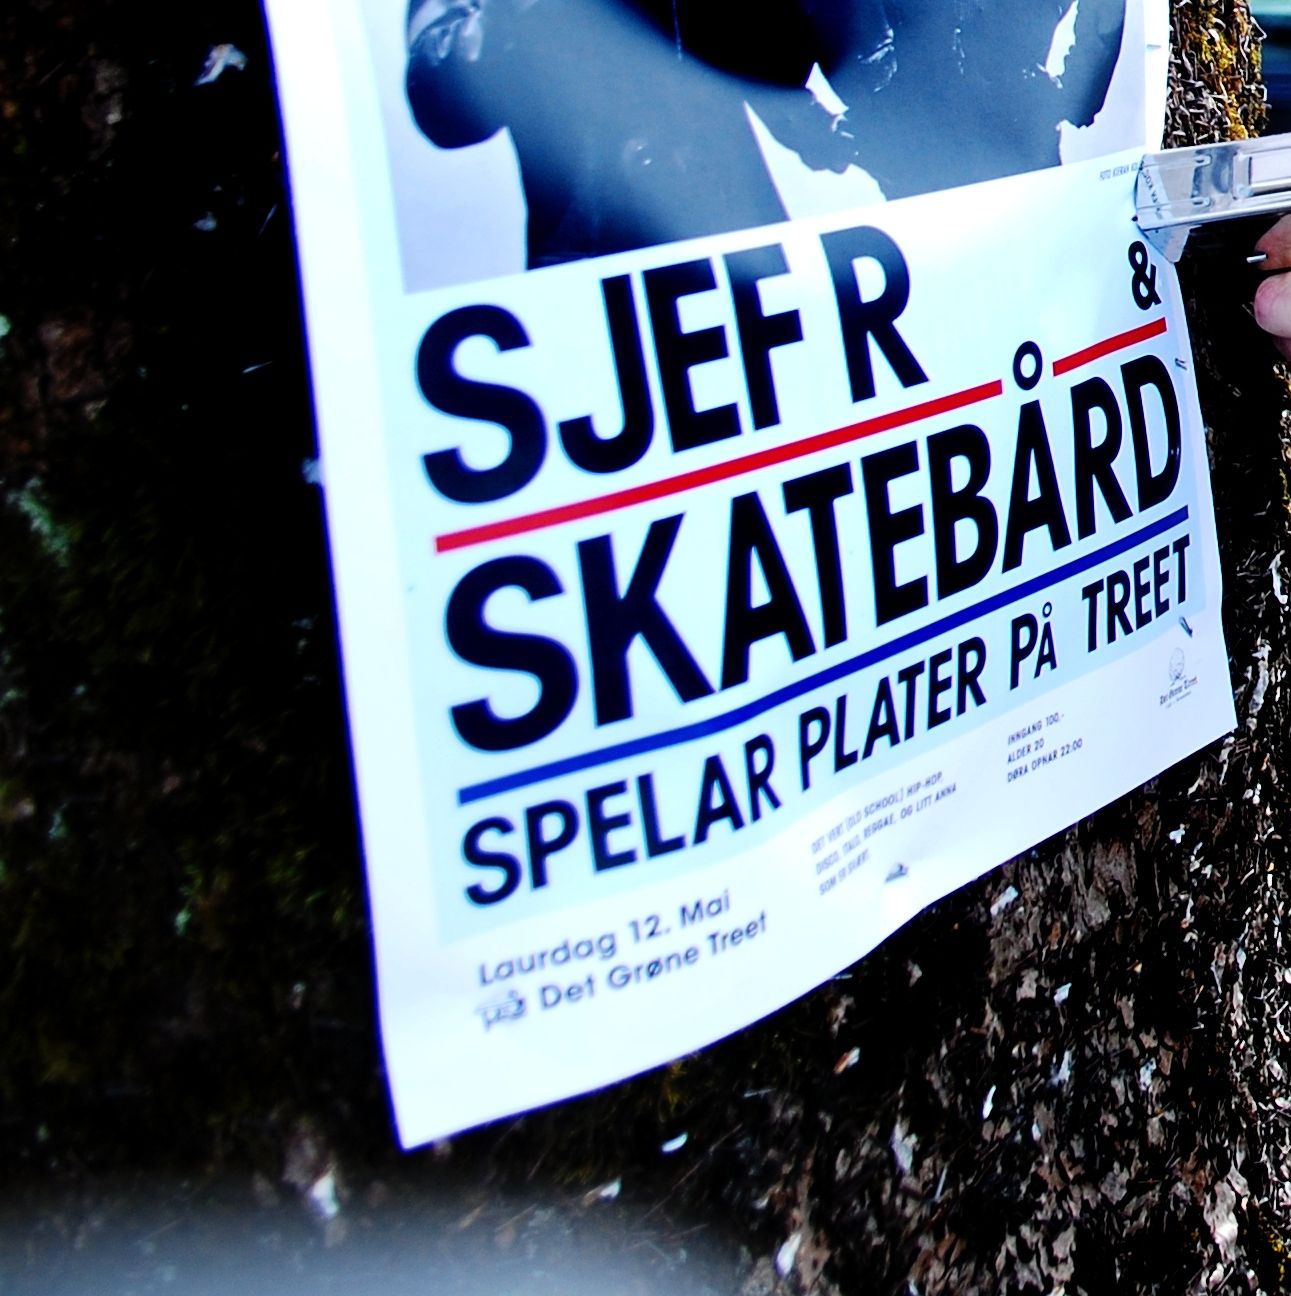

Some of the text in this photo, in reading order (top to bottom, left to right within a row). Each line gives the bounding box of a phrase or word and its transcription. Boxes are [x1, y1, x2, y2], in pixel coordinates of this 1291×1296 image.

[414, 224, 1162, 504] SJEF R &
[444, 339, 1183, 753] SKATEBÅRD
[462, 535, 1192, 908] SPELAR PLATER PÅ TREET
[1007, 719, 1042, 745] INNGANG
[1007, 737, 1045, 764] ALDER 20
[1007, 737, 1083, 783] DØRA OPNAR 22:00
[900, 804, 913, 820] OG
[935, 783, 957, 802] ANNA
[479, 890, 731, 987] Laurdag 12. Mai
[540, 973, 597, 1009] Det
[608, 945, 699, 989] Grøne
[708, 910, 768, 955] Treet
